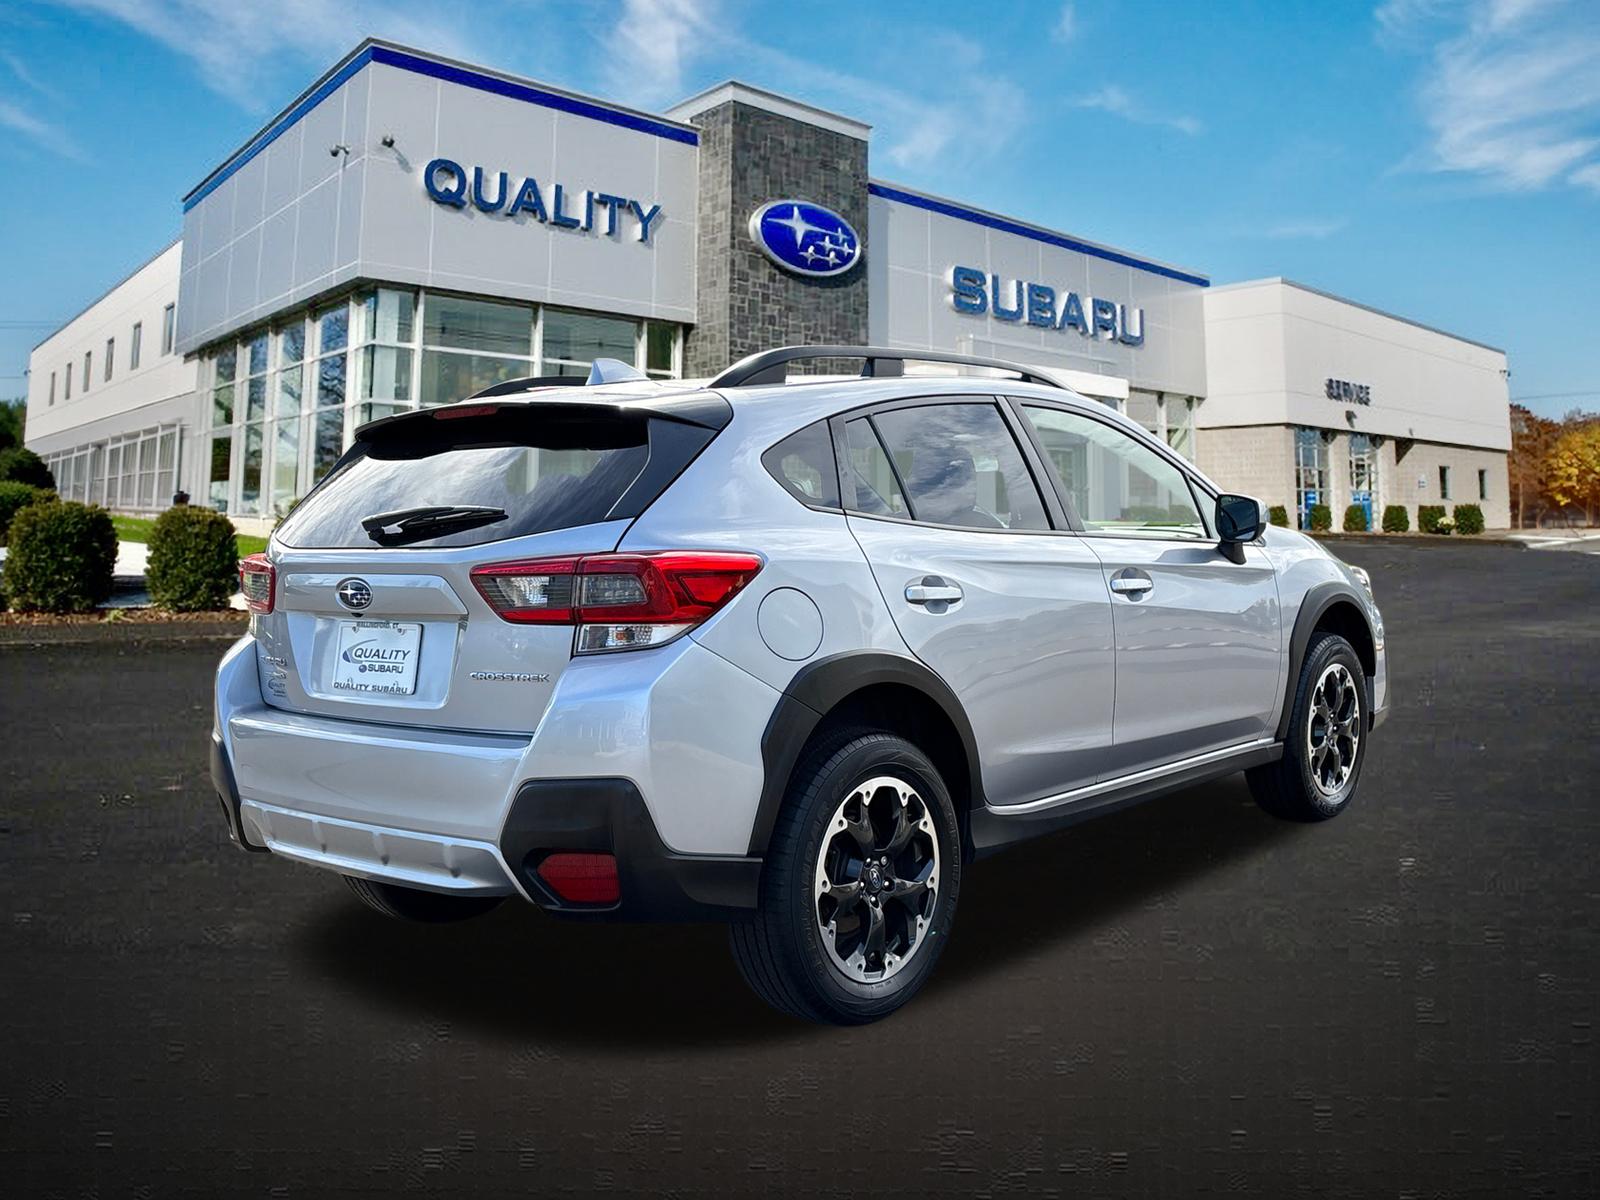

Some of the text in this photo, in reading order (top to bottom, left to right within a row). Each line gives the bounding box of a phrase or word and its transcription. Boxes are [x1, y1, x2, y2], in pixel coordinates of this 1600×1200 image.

[424, 158, 661, 243] QUALITY
[951, 265, 1145, 347] SUBARU
[354, 647, 411, 661] QUALITY
[367, 663, 404, 674] SUBARU
[470, 672, 550, 682] CROSSTREK
[333, 681, 408, 695] QUALITY SUBARU
